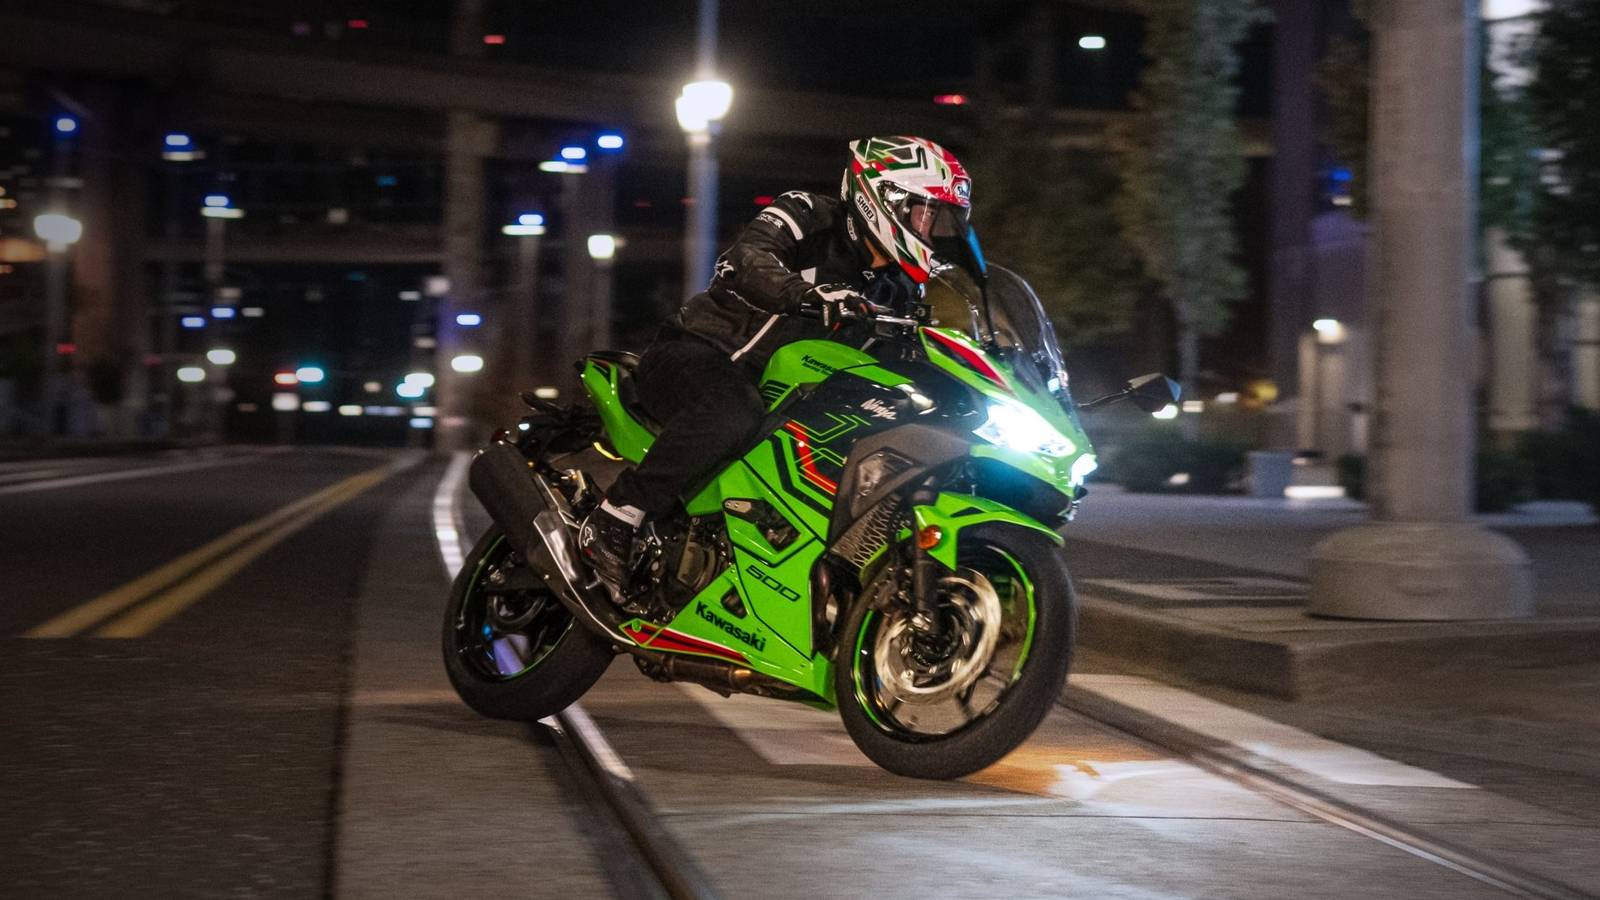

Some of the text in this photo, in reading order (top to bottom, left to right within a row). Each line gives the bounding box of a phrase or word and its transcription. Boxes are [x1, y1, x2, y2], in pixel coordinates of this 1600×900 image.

[857, 195, 874, 219] SHOEI
[860, 398, 896, 420] Ninja
[746, 565, 800, 602] 500
[696, 601, 767, 652] Kawasaki
